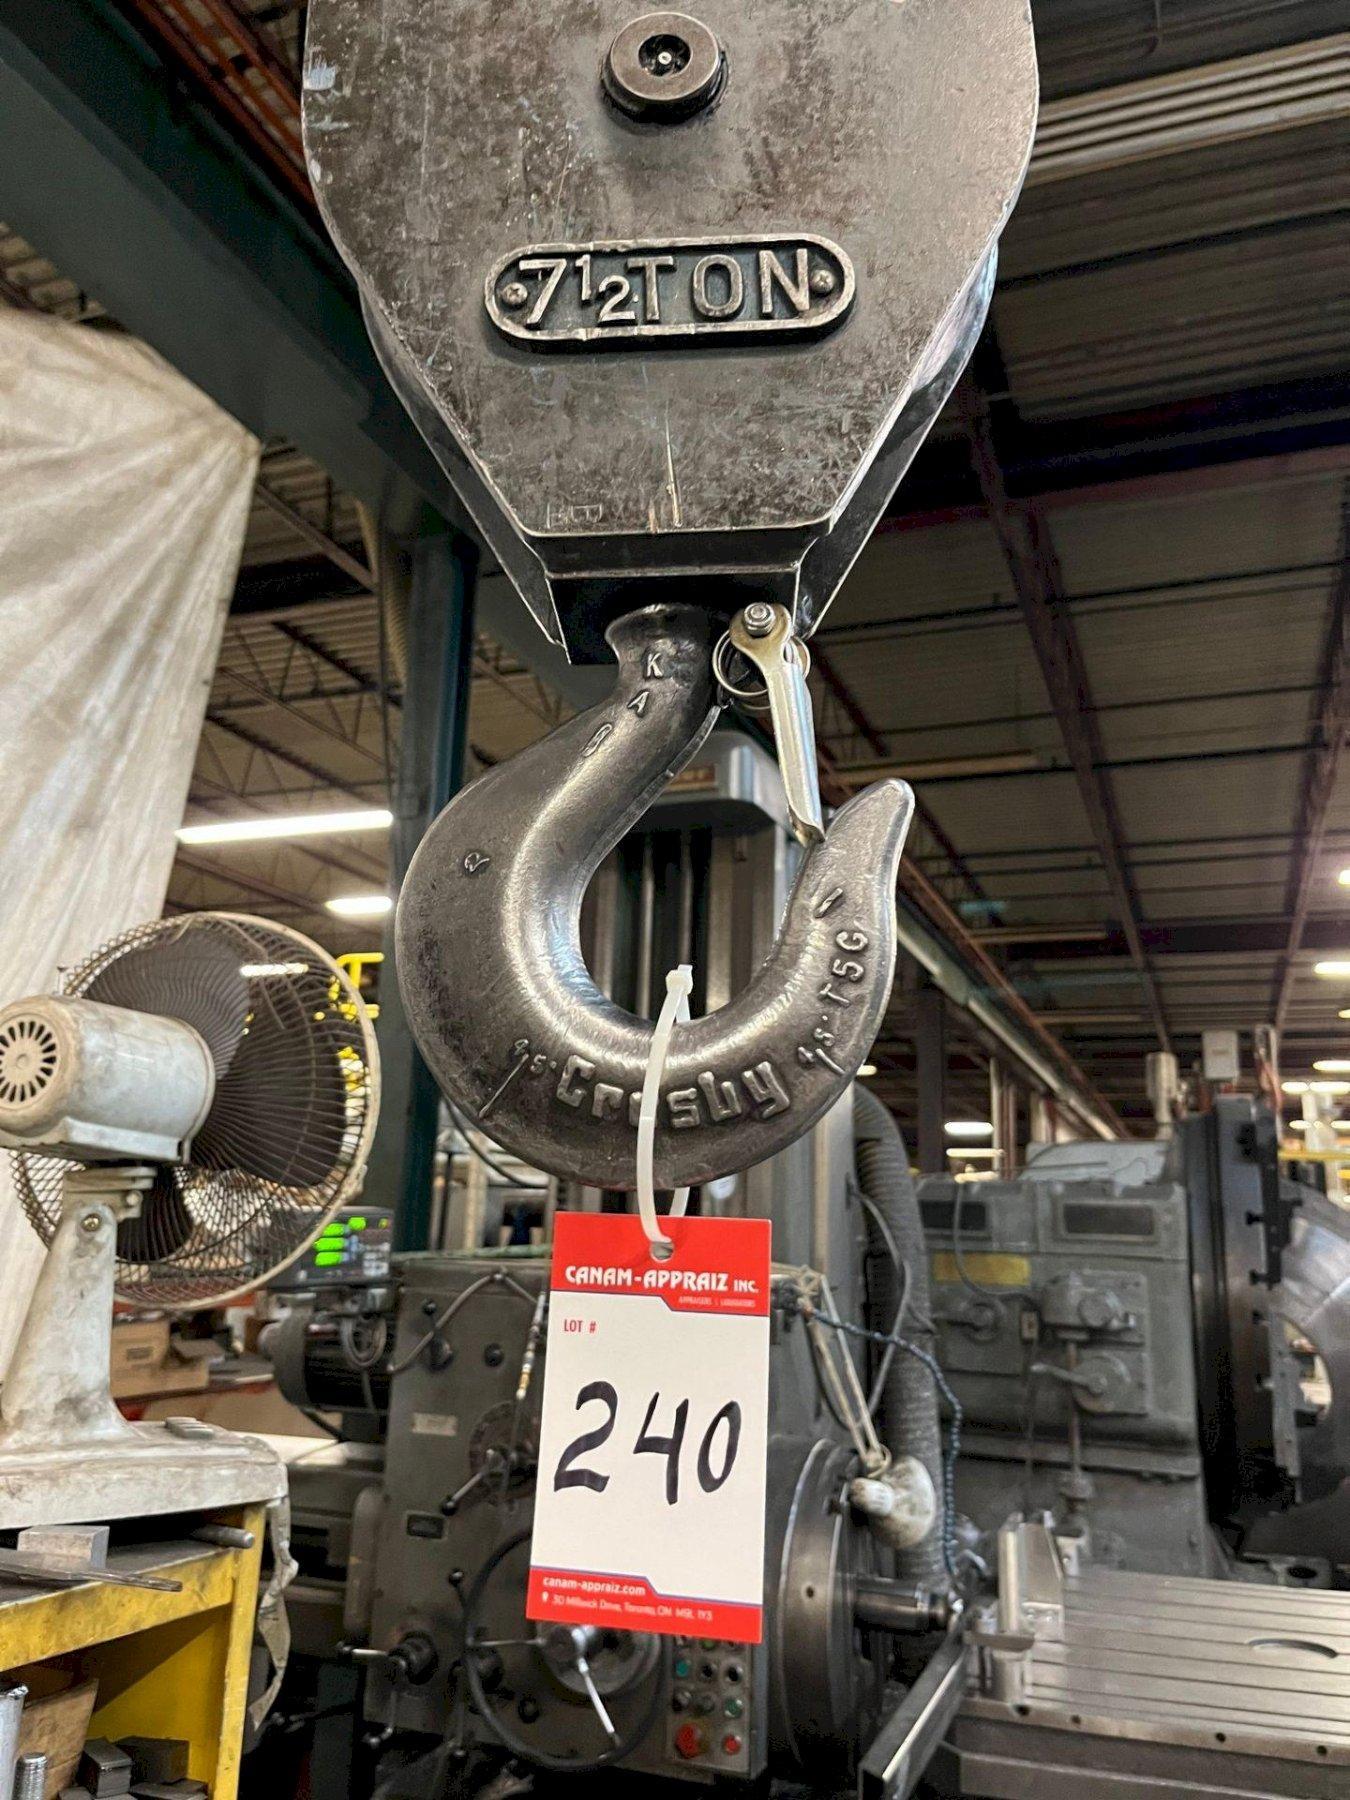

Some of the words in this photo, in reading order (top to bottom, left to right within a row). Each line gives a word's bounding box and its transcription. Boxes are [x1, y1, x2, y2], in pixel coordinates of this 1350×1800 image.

[627, 248, 810, 322] TON
[565, 1265, 729, 1292] CANAM-APPRAIZ
[563, 1319, 583, 1333] LOT
[554, 1380, 742, 1506] 240
[542, 1576, 646, 1597] canam-appraiz.com
